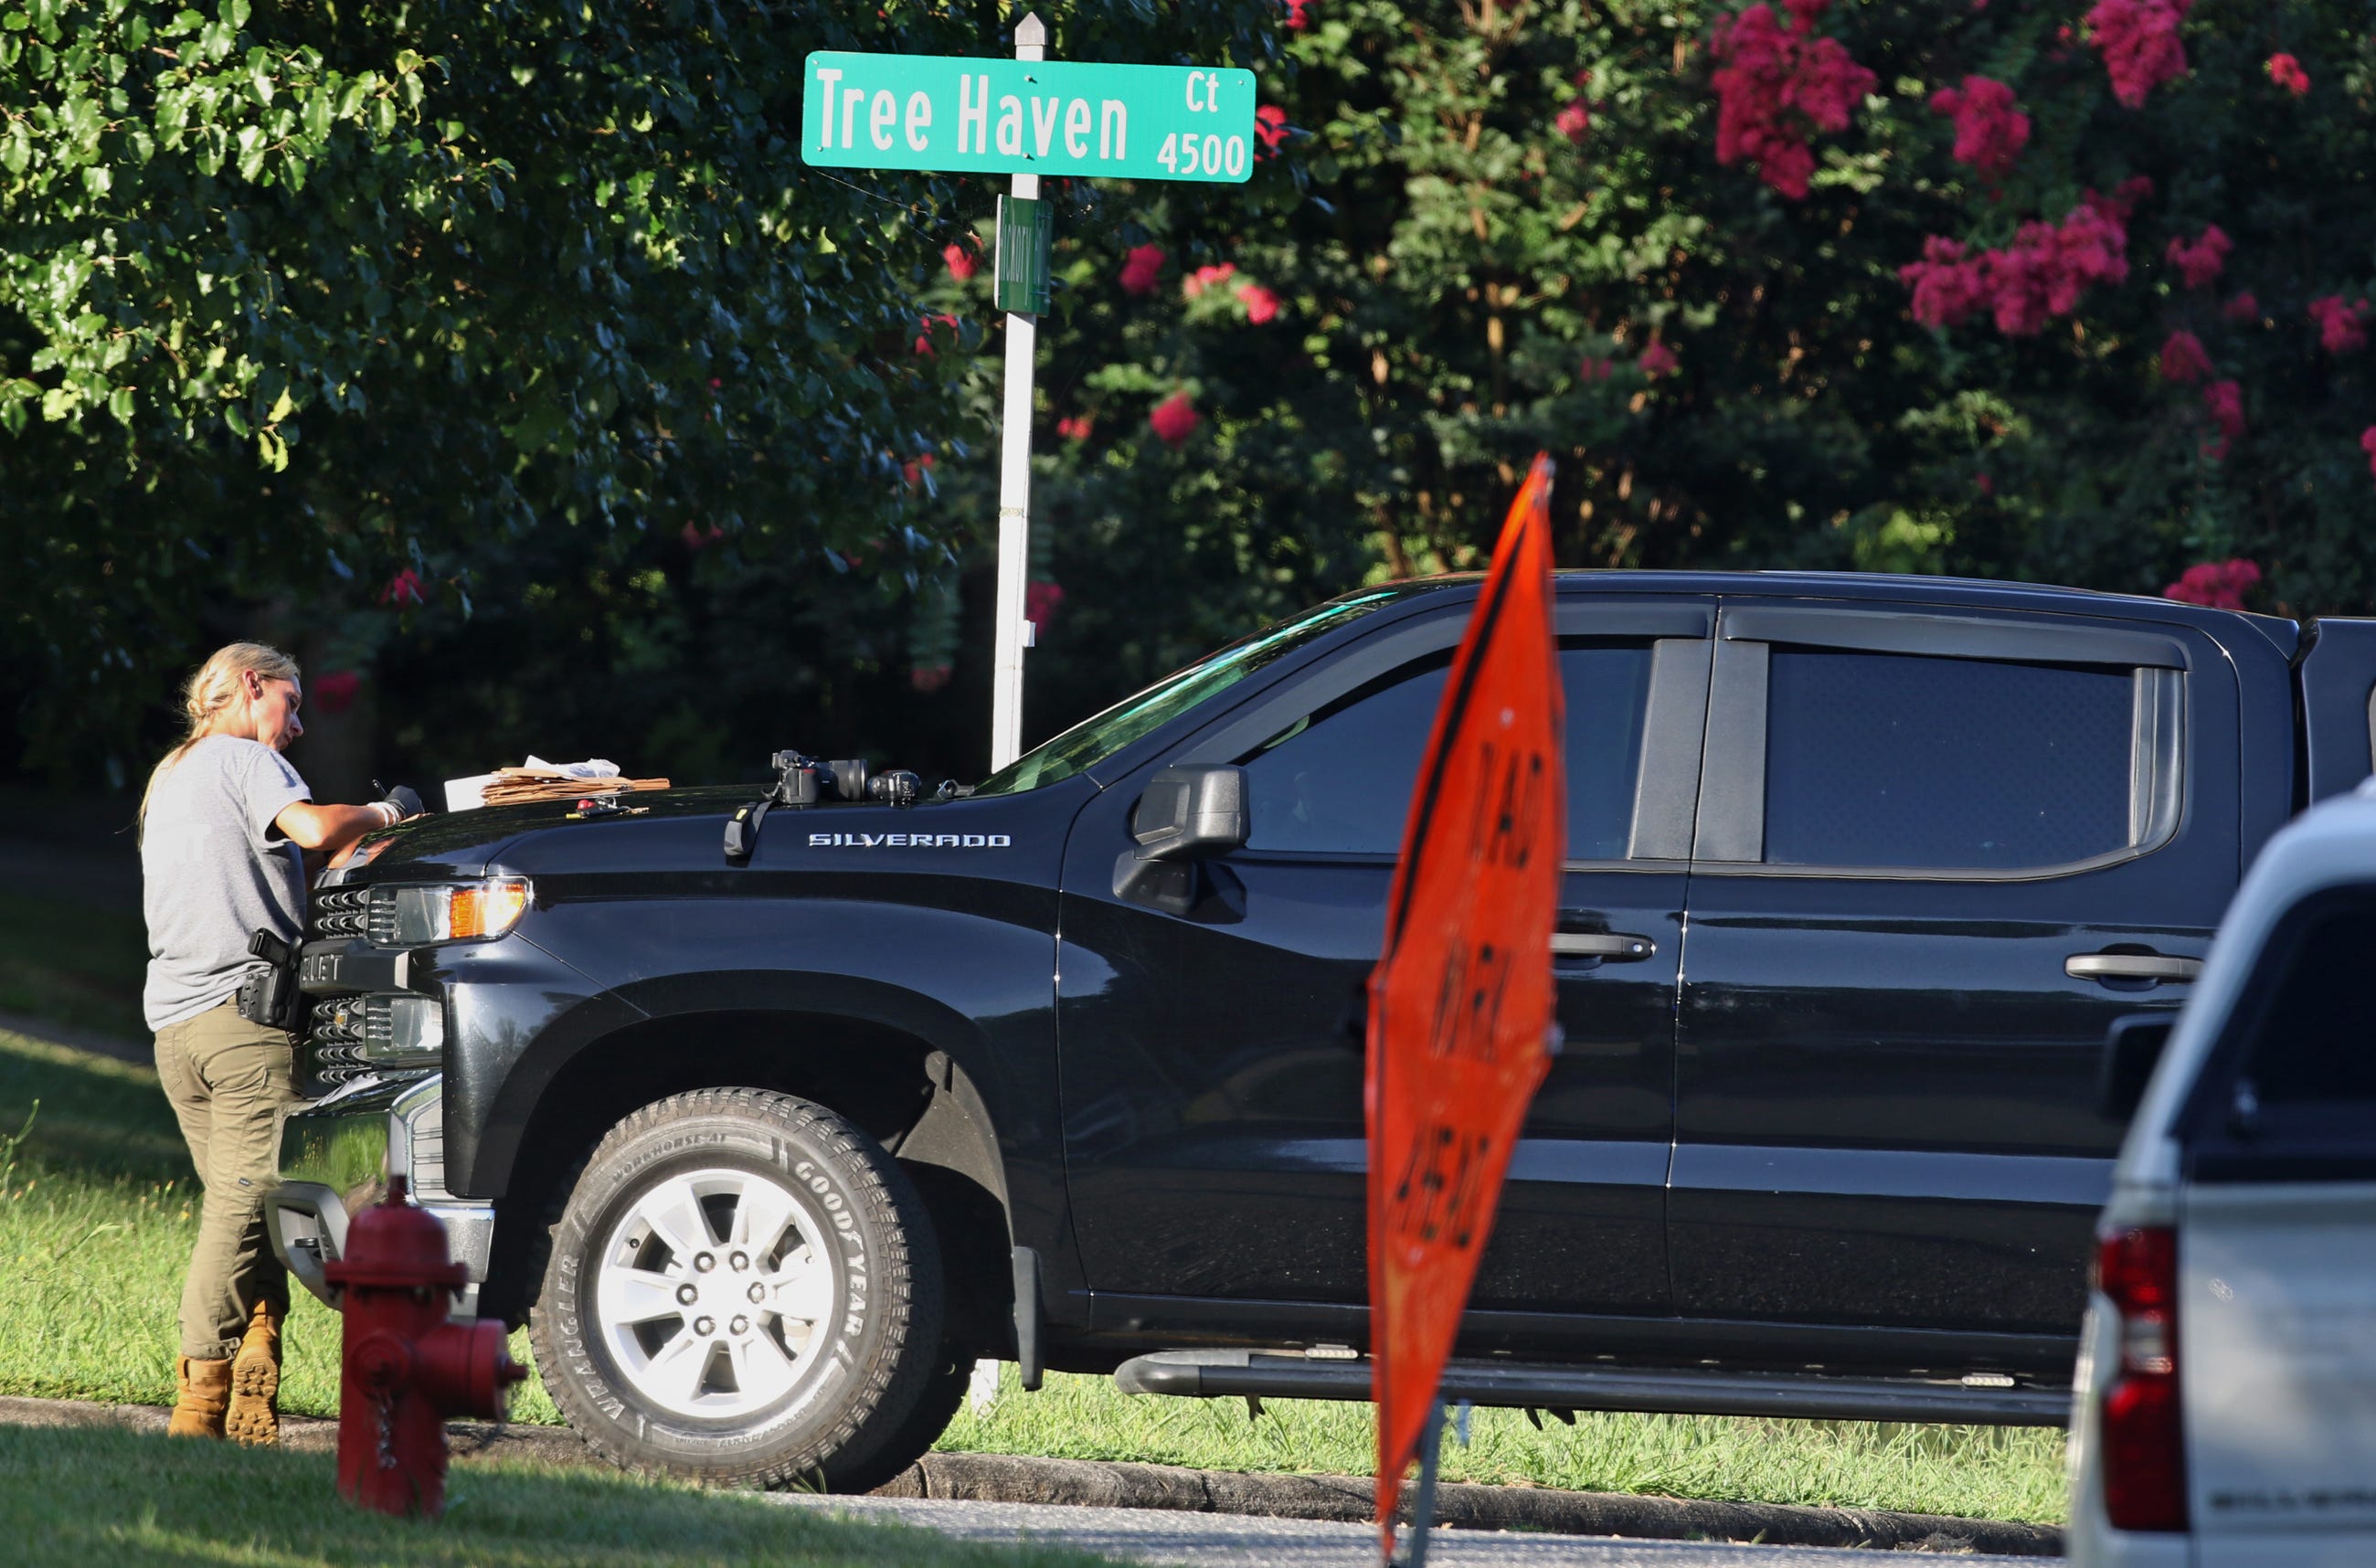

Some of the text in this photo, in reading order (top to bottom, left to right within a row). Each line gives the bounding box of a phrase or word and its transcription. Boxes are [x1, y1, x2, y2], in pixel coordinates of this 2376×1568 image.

[816, 69, 1219, 160] Tree Haven Ct
[1157, 132, 1245, 176] 4500
[808, 832, 1012, 848] SILVERADO
[611, 1132, 729, 1185] WORKHORSE AT
[794, 1160, 868, 1337] GOODYEAR
[557, 1254, 626, 1421] WRANGLER
